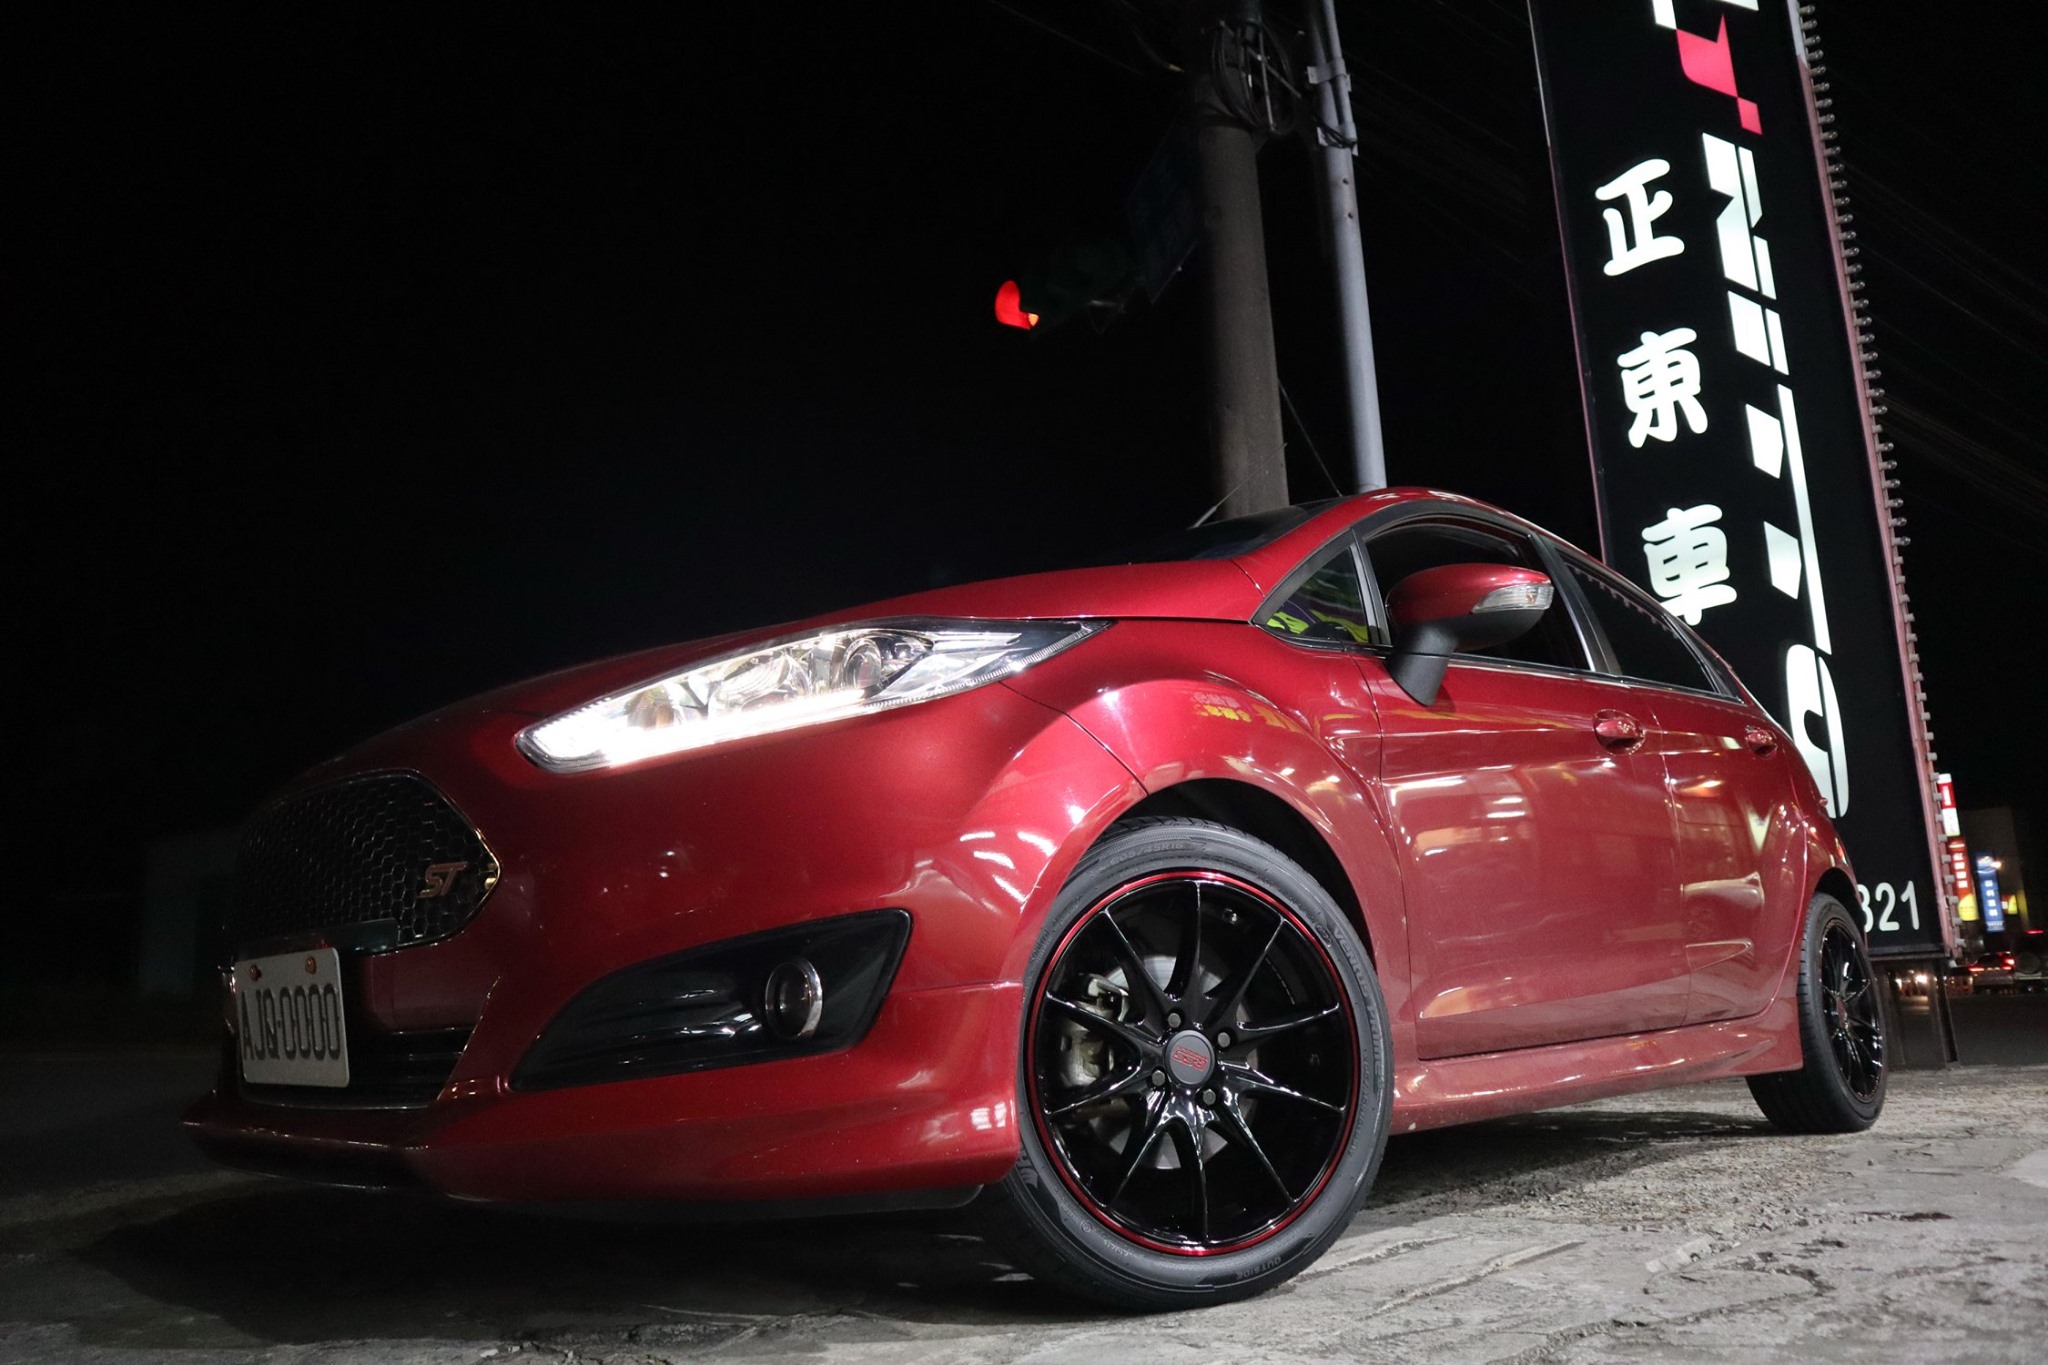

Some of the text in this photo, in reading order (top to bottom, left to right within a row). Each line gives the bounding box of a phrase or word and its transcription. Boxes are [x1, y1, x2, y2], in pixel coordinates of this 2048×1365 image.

[1595, 158, 1737, 627] 正東車
[1701, 132, 1849, 819] NITTO
[416, 861, 469, 899] ST
[241, 983, 341, 1061] AJQ-0000
